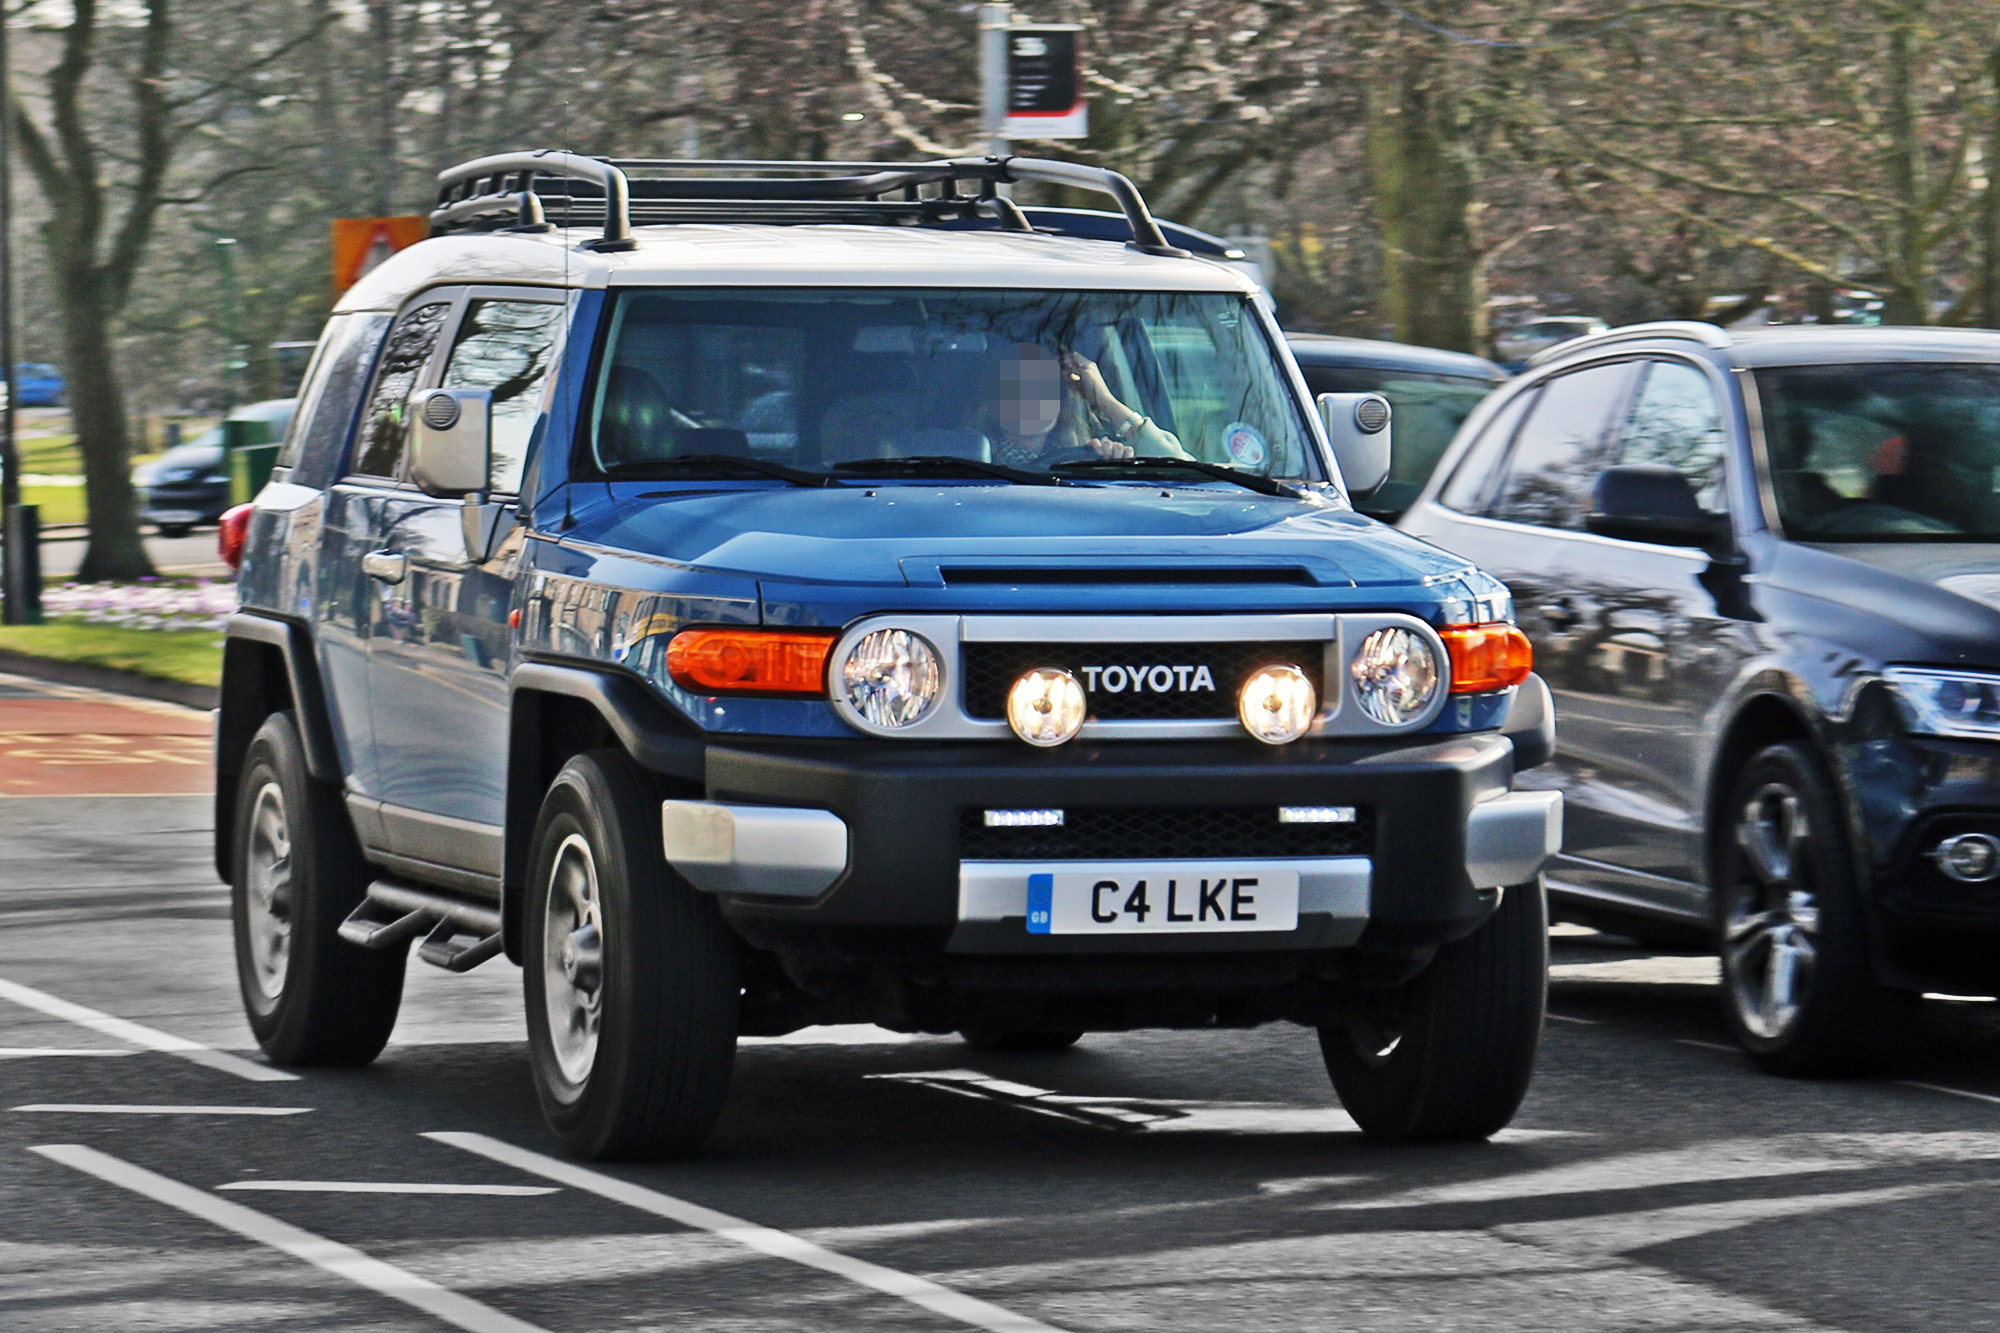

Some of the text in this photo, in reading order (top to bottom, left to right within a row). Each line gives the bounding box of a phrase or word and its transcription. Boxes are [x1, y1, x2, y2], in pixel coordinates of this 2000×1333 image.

[1081, 665, 1216, 693] TOYOTA
[1091, 878, 1259, 923] C4 LKE
[1031, 911, 1049, 924] GB
